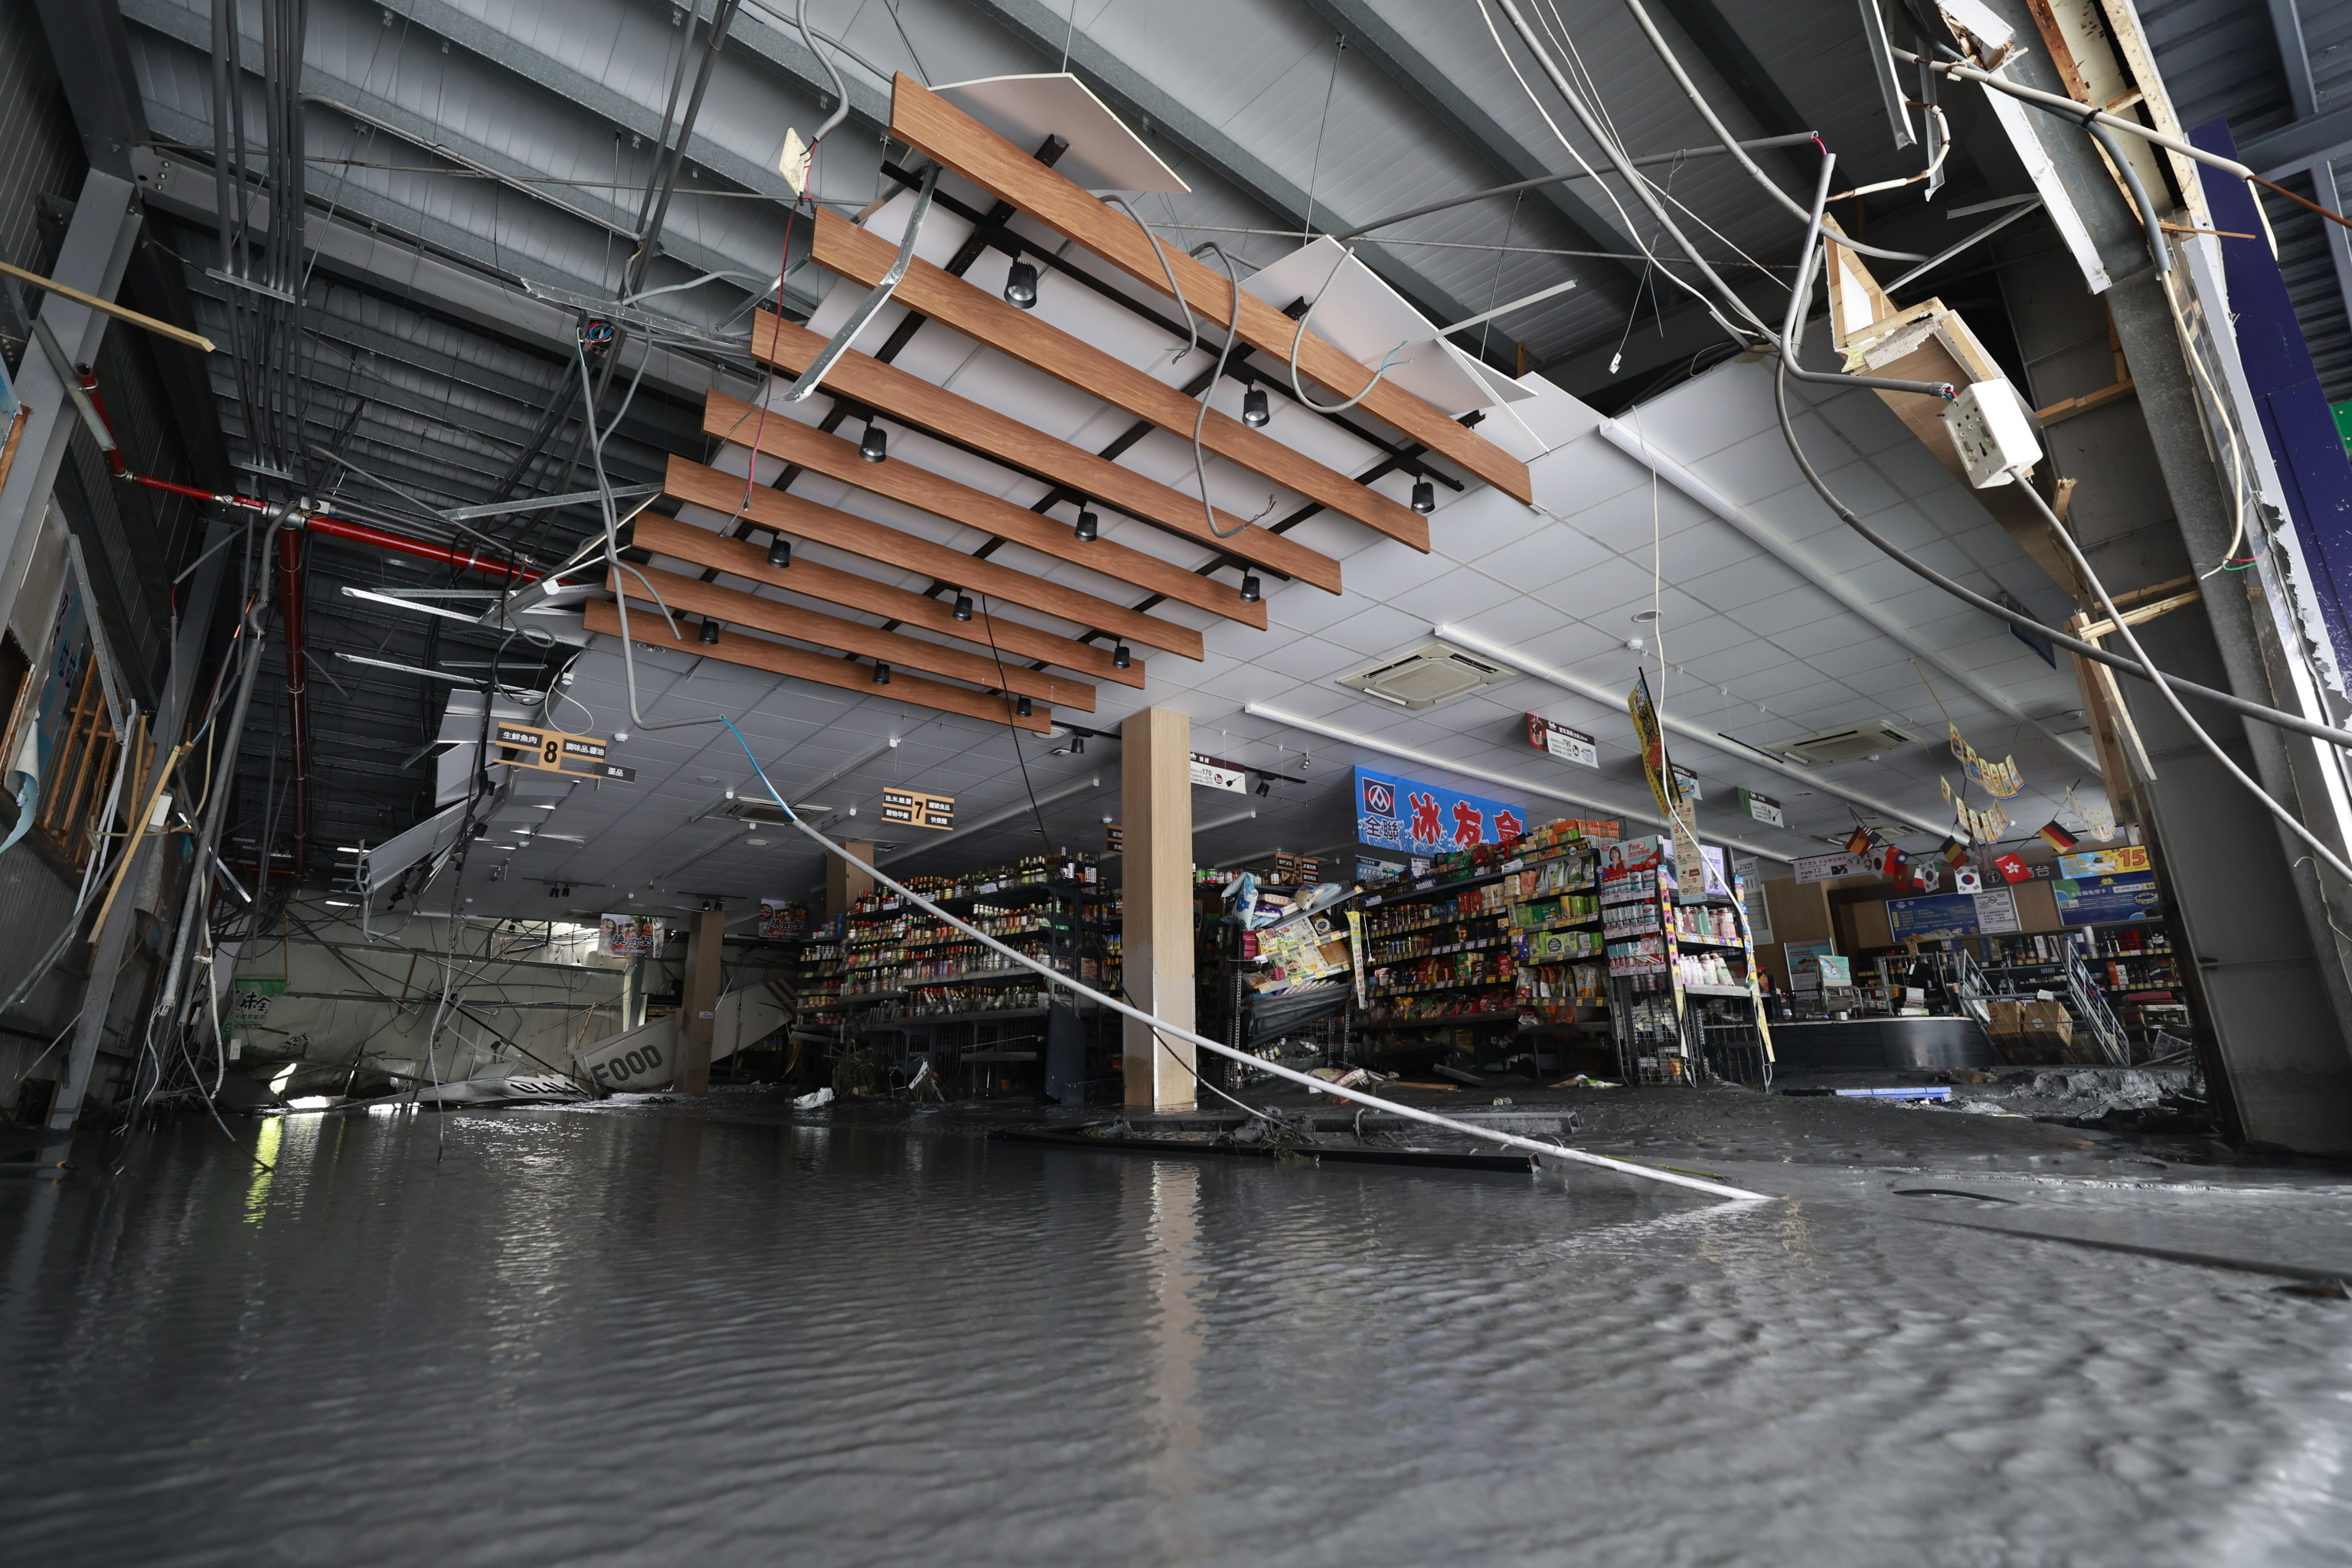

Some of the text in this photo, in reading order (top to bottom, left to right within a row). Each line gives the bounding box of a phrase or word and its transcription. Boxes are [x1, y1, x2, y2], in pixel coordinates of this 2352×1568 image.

[502, 731, 537, 744] 生鮮魚肉
[544, 741, 558, 763] 8
[608, 766, 624, 777] 蛋品
[915, 801, 924, 819] 7
[1365, 815, 1400, 841] 全聯
[590, 1044, 663, 1083] FOOD
